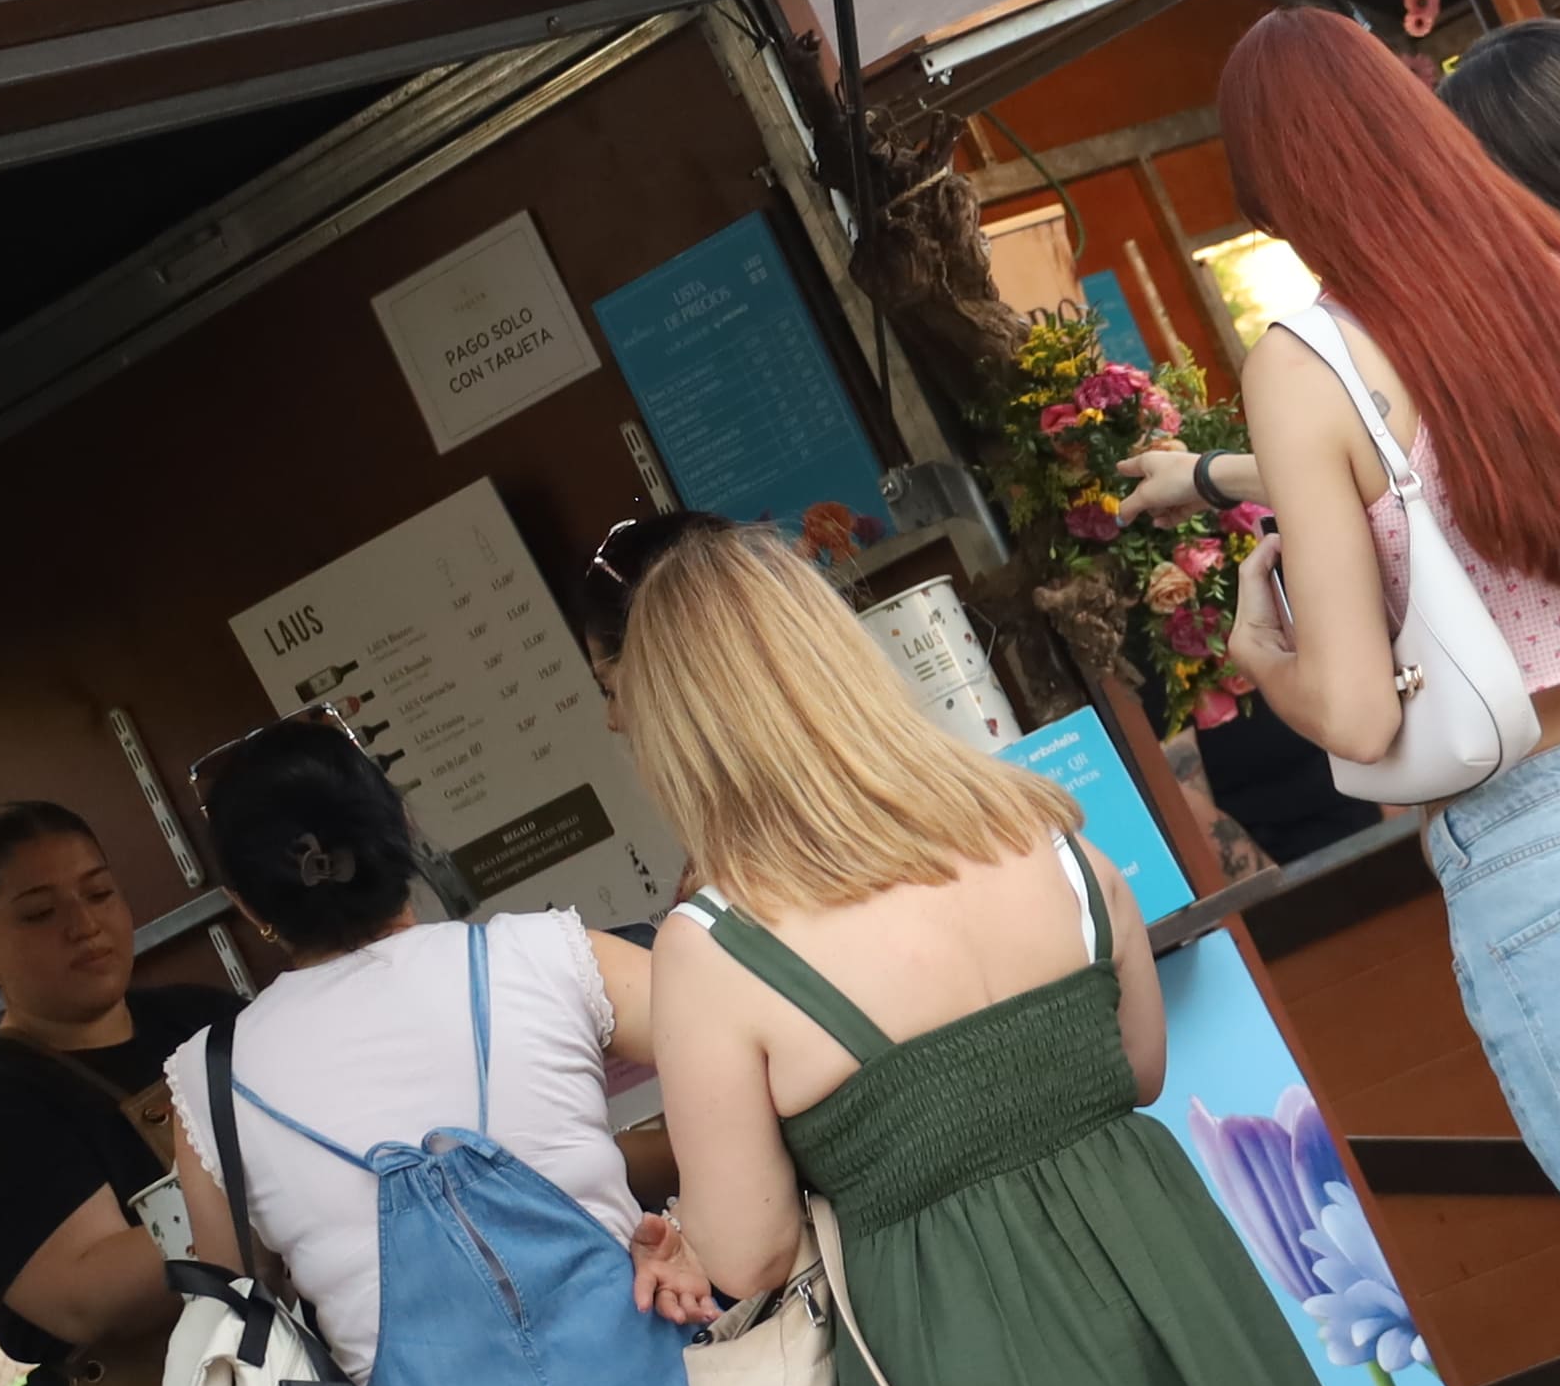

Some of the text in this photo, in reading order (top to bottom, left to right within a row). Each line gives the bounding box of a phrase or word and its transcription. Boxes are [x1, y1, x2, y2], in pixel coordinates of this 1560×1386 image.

[445, 307, 533, 367] PAGO SOLO
[449, 328, 555, 394] CON TARJETA
[263, 604, 325, 657] LAUS
[902, 627, 945, 662] LAUS
